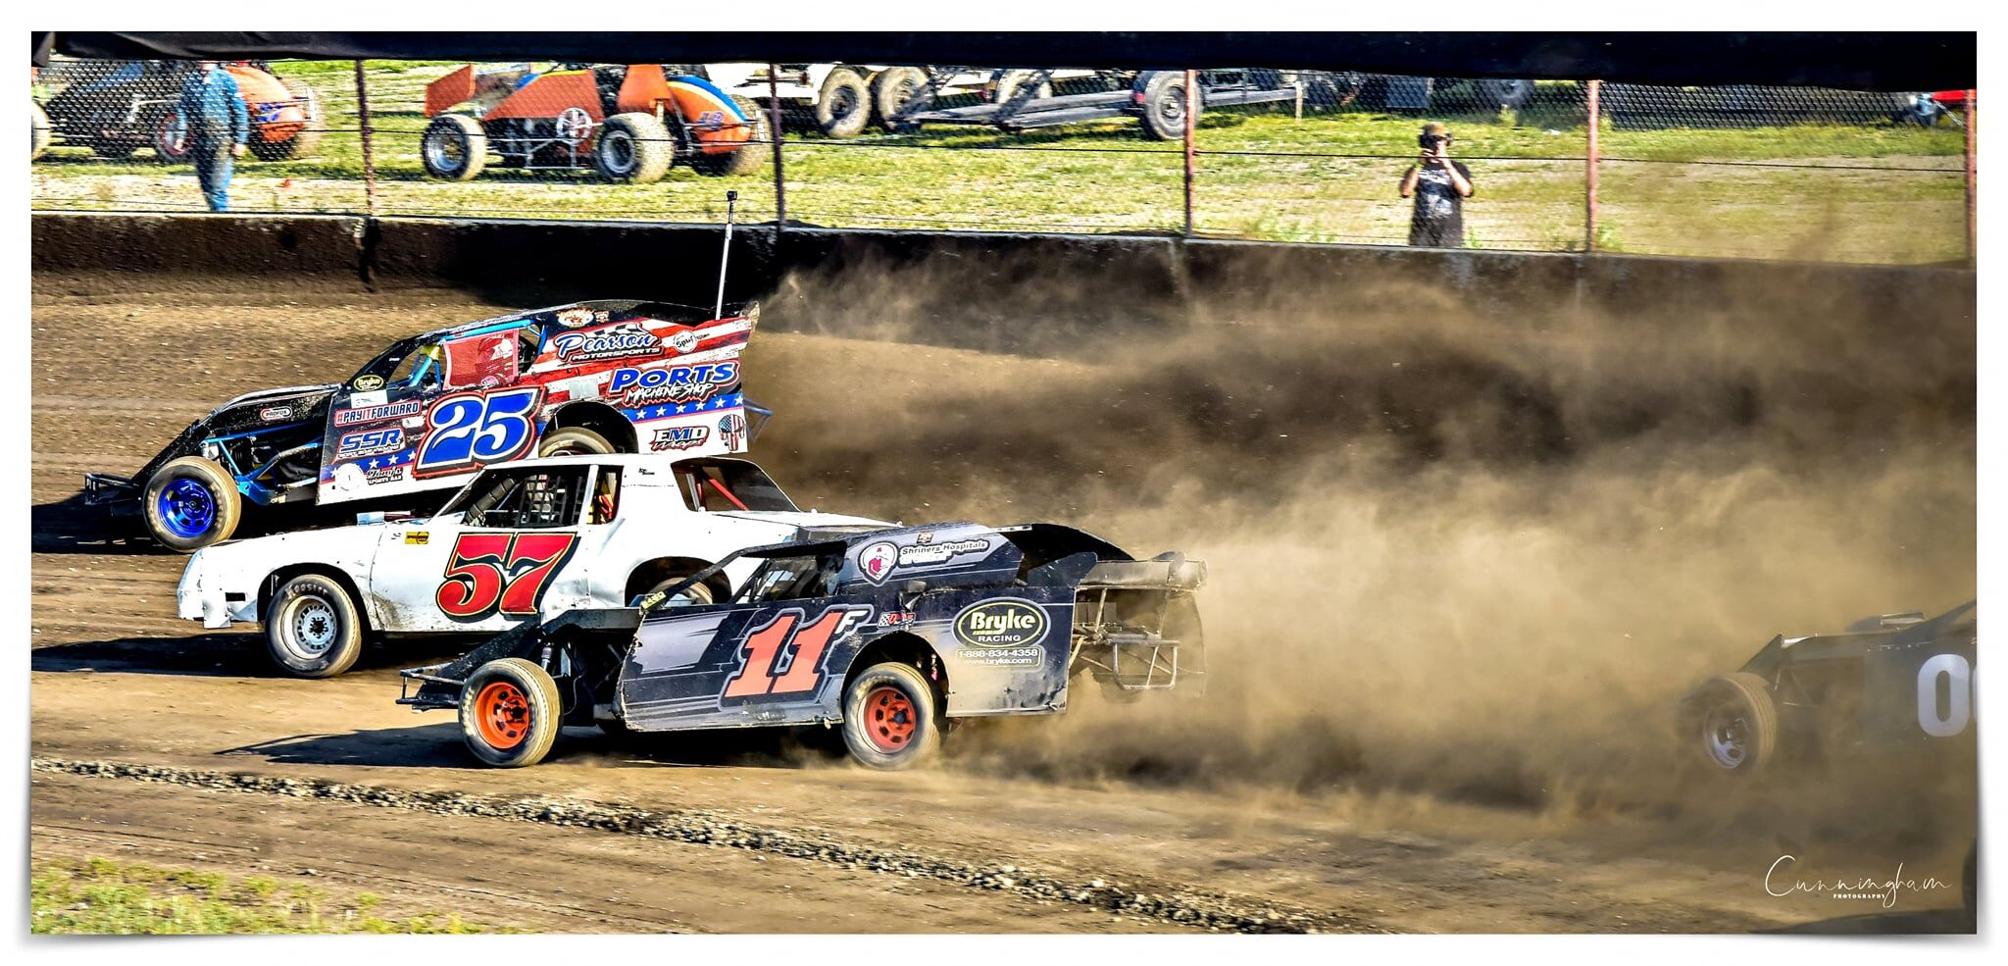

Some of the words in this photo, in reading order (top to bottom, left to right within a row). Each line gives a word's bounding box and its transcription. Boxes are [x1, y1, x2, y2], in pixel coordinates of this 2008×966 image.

[557, 333, 656, 358] Pearson
[572, 347, 661, 361] MOTORSPORTS
[609, 362, 737, 393] PORTS
[624, 386, 682, 403] MACHINE
[679, 383, 714, 399] SHOP
[337, 402, 419, 424] #PAYITFORWARD
[341, 430, 401, 451] SSR
[416, 388, 536, 469] 25
[902, 547, 941, 555] Shriners
[943, 541, 986, 553] Hospitals
[436, 532, 579, 617] 57
[970, 609, 1036, 634] Bryke
[1918, 653, 1976, 736] 0
